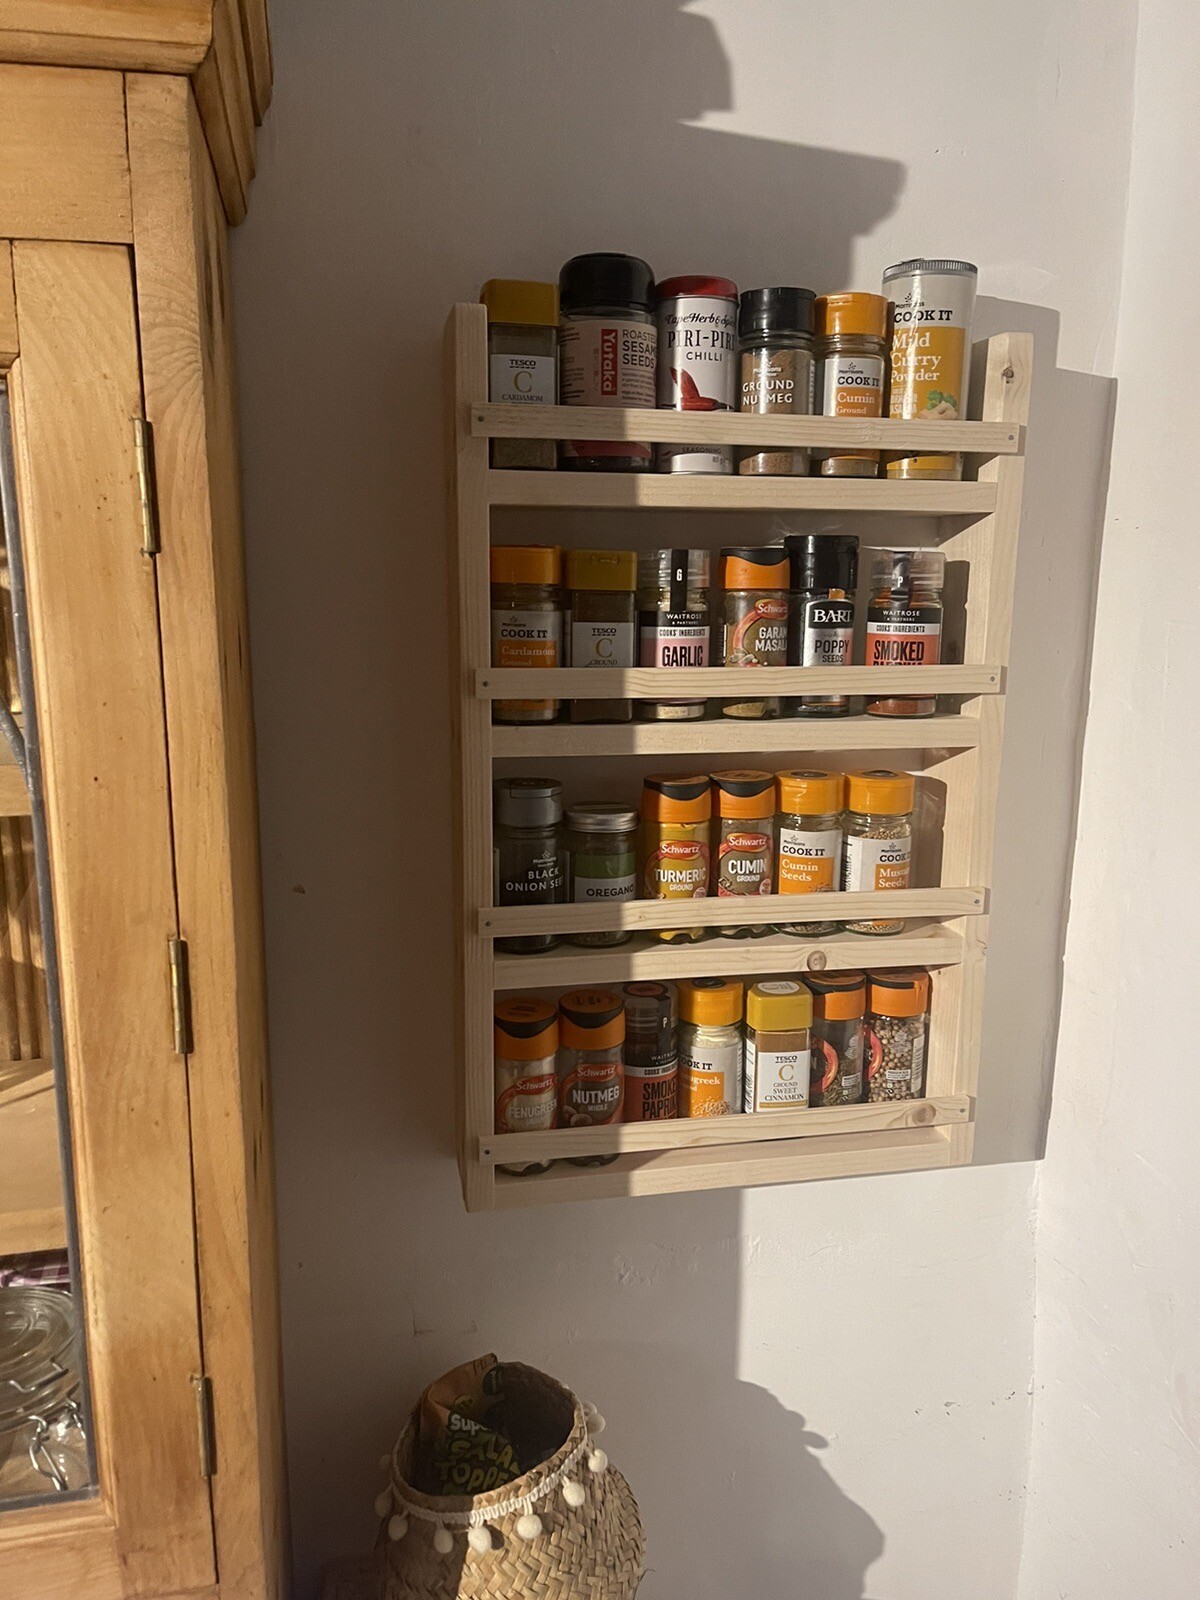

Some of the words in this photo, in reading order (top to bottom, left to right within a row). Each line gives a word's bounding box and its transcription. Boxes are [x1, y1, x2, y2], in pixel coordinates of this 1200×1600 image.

[894, 310, 935, 323] COOK
[938, 310, 953, 321] IT
[622, 329, 657, 344] ROASTE
[622, 340, 658, 356] SESAM
[603, 332, 616, 391] Yutaka
[622, 353, 656, 369] SEEDS
[686, 352, 722, 361] CHILLI
[514, 371, 532, 393] C
[838, 376, 870, 386] COOK
[872, 377, 880, 387] IT
[743, 394, 793, 406] NUMEG
[838, 392, 875, 403] Cumin
[837, 406, 867, 414] Ground
[676, 568, 683, 581] G
[898, 576, 904, 588] P
[501, 629, 534, 638] COOK
[537, 630, 547, 638] IT
[595, 638, 612, 658] C
[755, 639, 787, 651] MASAL
[815, 640, 849, 653] POPPY
[874, 640, 924, 662] SMOKED
[662, 646, 703, 667] GARLIC
[729, 836, 768, 846] Schwartz
[782, 845, 812, 856] COOK
[815, 848, 826, 856] IT
[728, 859, 767, 874] CUMIN
[781, 858, 818, 871] Cumin
[528, 867, 560, 880] BLACK
[654, 867, 706, 883] TURMERIC
[781, 869, 812, 881] Seeds
[505, 882, 547, 892] ONION
[586, 884, 635, 897] OREGANO
[663, 1017, 668, 1028] P
[680, 1057, 700, 1069] OOK
[778, 1064, 794, 1082] C
[572, 1085, 619, 1104] NUTMEG
[643, 1079, 677, 1101] SMOKE
[764, 1093, 805, 1101] CINNAMON
